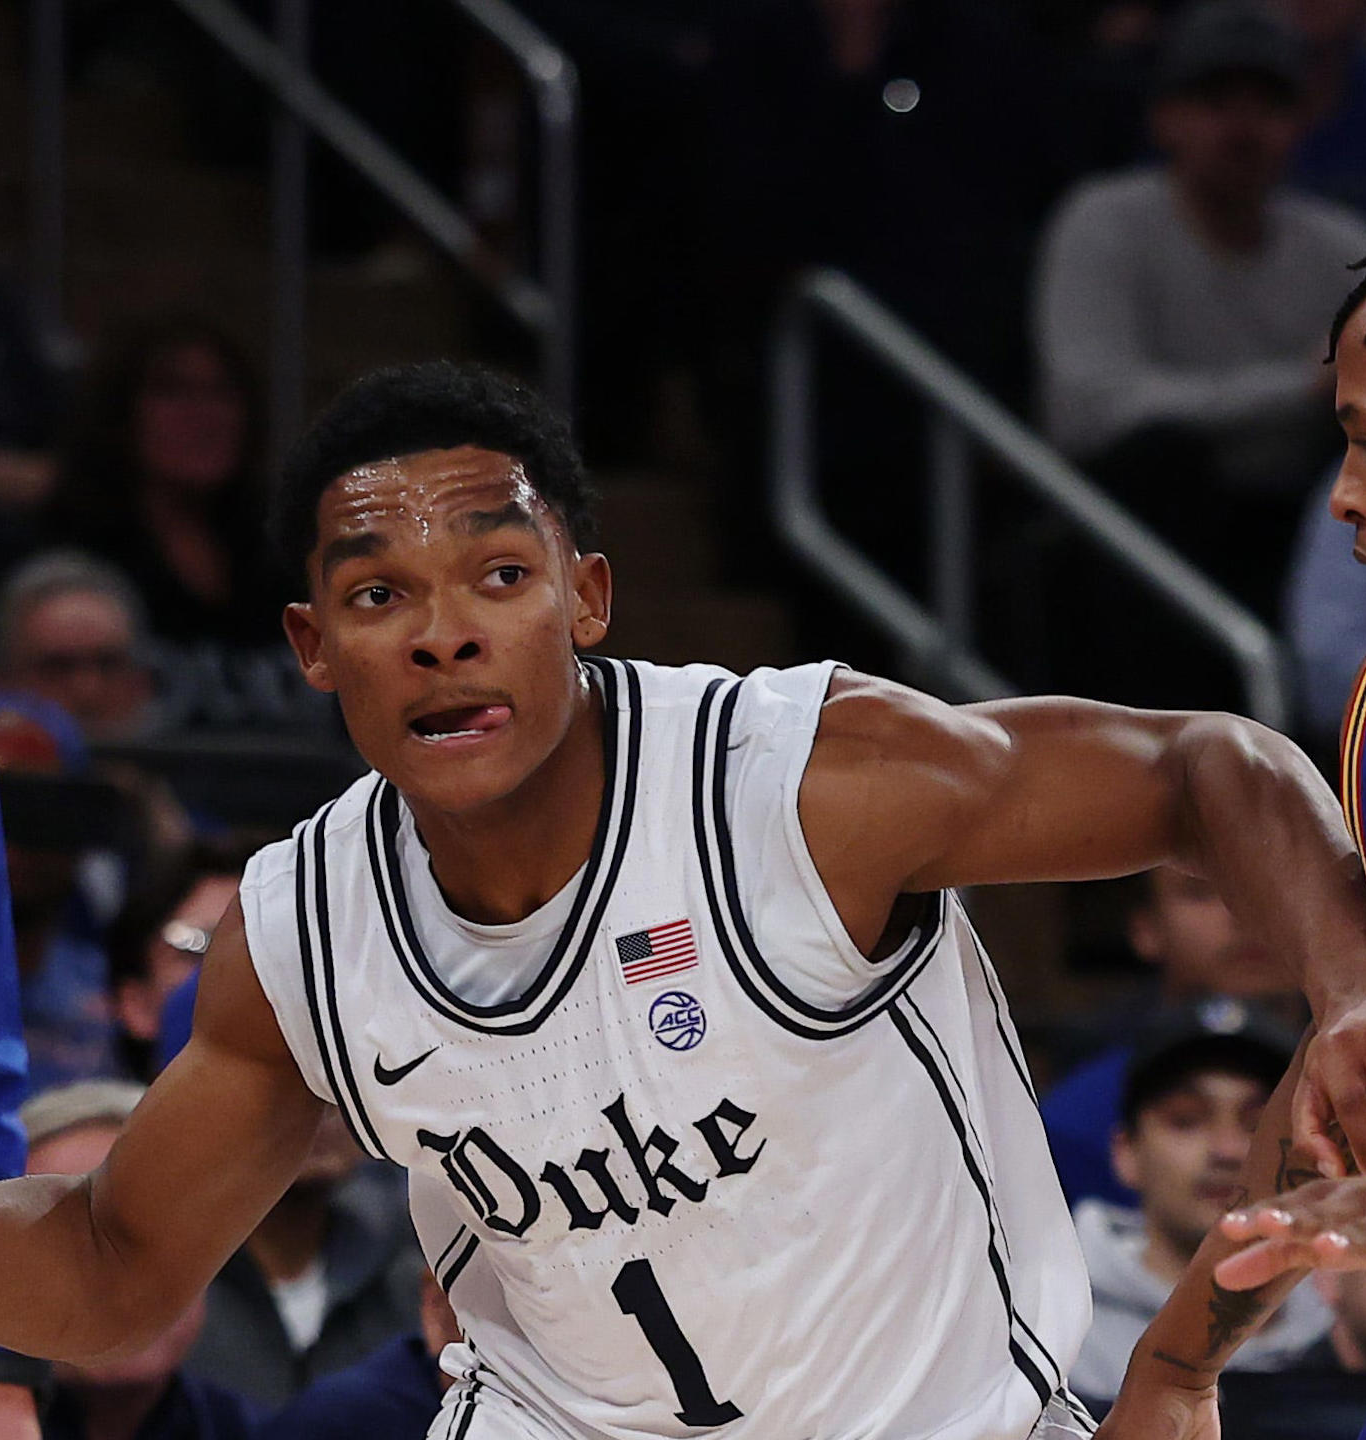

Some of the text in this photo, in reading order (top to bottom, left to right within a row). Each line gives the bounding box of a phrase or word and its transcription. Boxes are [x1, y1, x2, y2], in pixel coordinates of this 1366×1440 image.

[657, 1006, 701, 1029] ACC
[416, 1092, 768, 1238] Duke
[611, 1258, 745, 1427] 1
